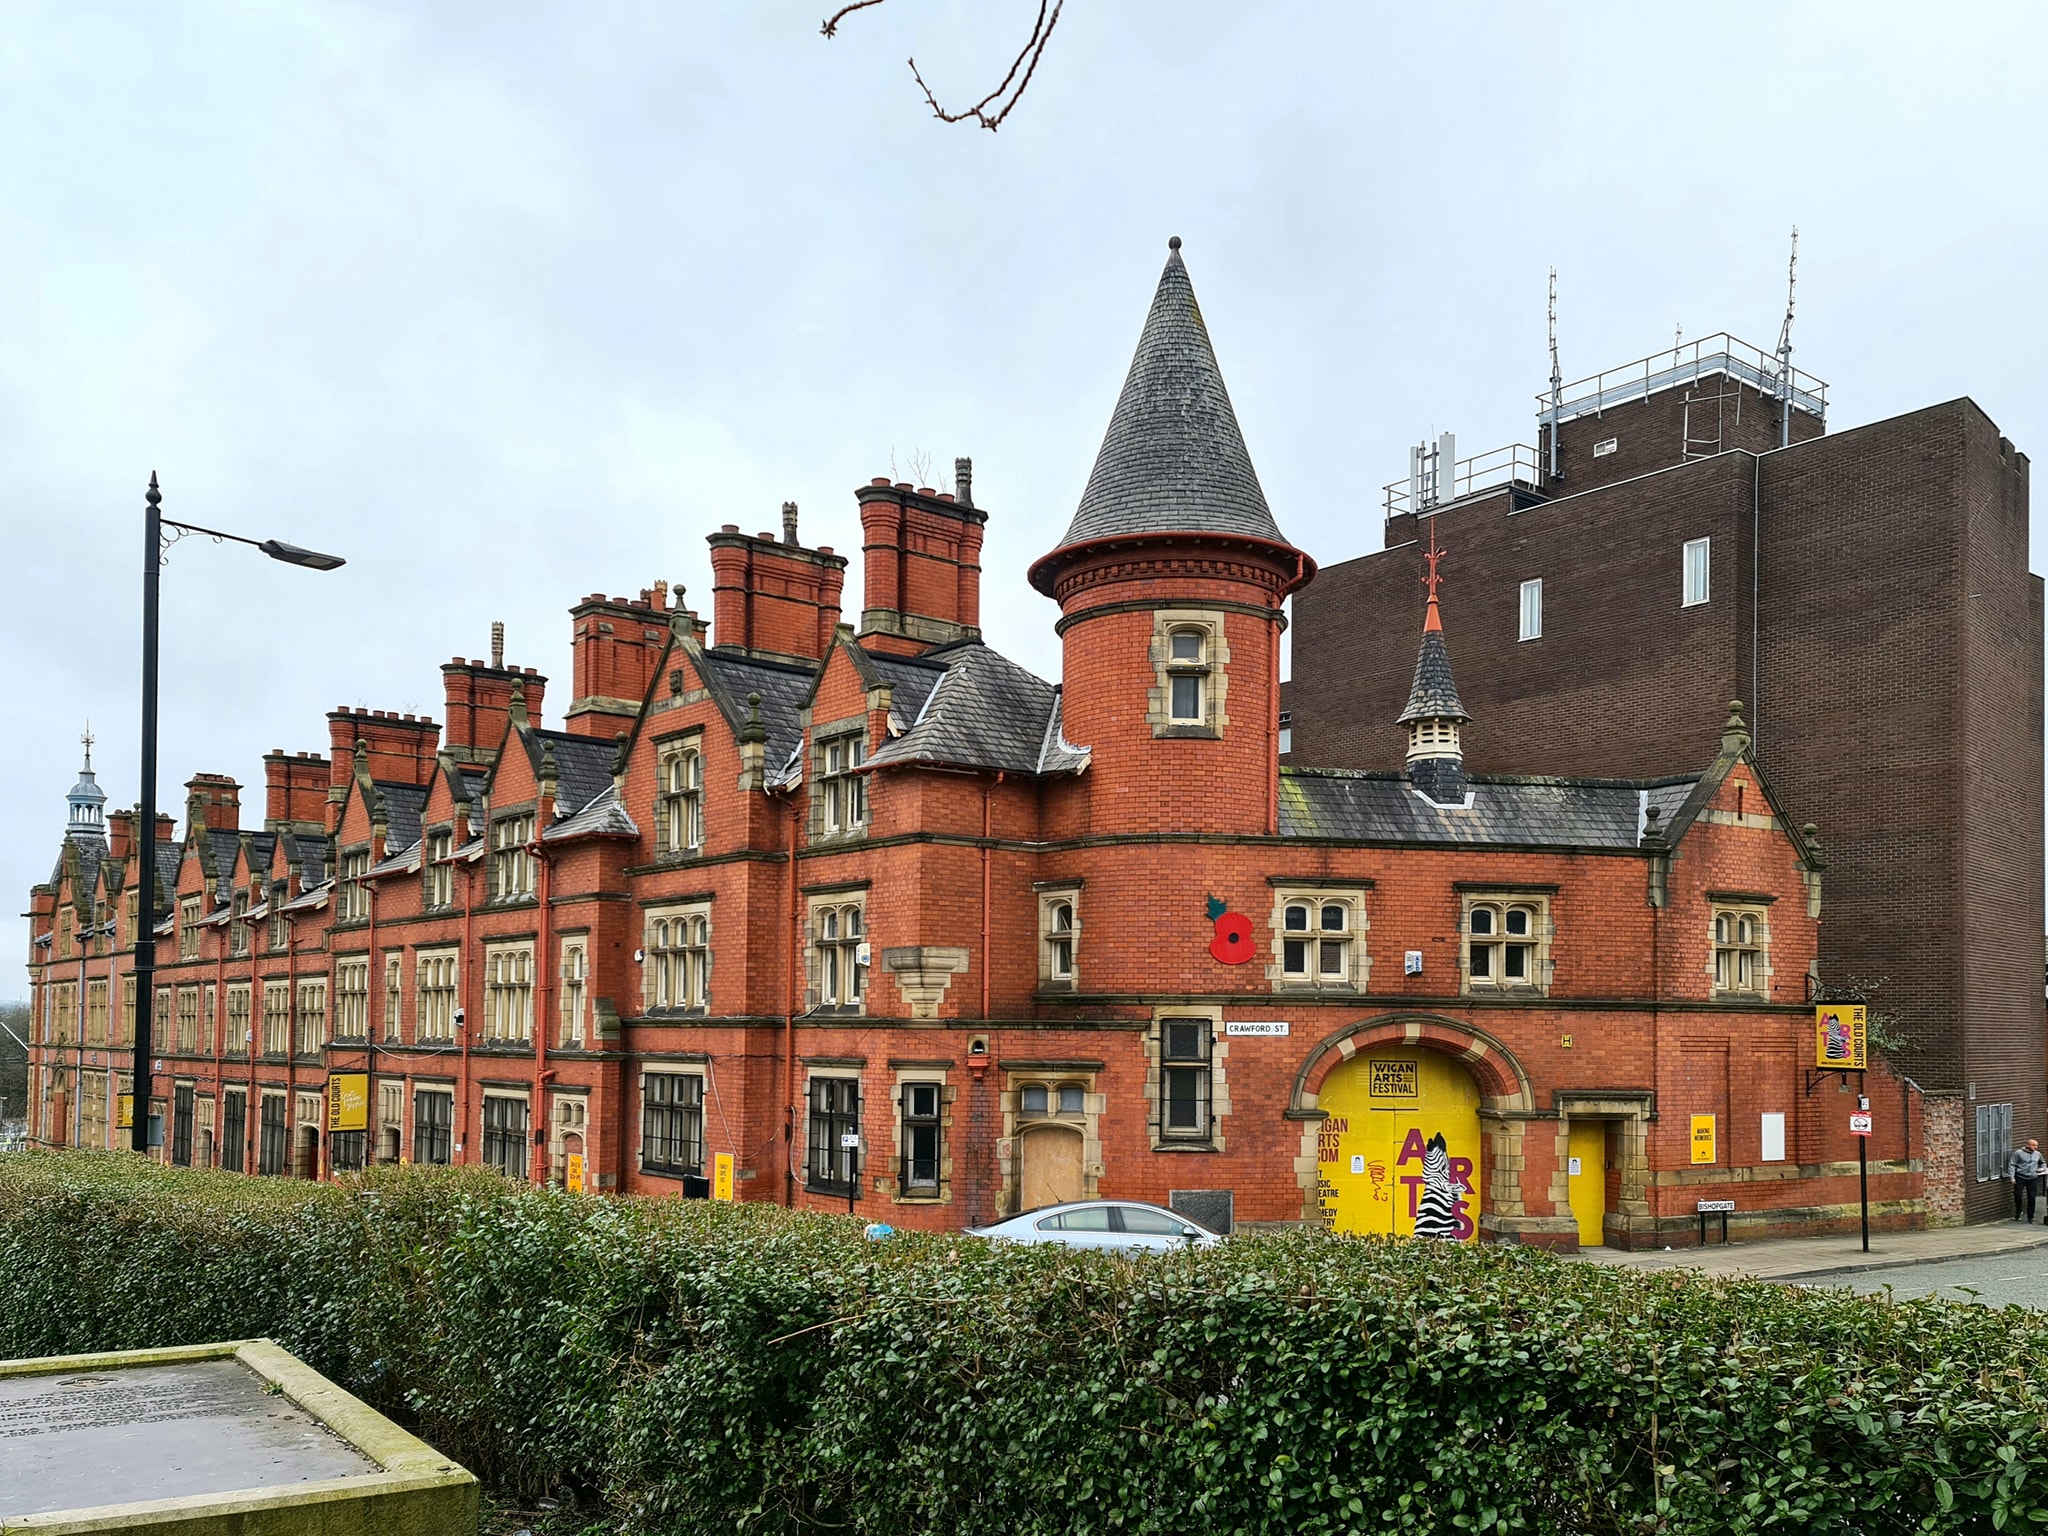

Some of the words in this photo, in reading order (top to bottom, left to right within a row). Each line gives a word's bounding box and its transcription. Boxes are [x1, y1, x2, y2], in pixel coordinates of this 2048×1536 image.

[1854, 1008, 1863, 1021] THE
[1854, 1023, 1863, 1037] OLD
[1854, 1038, 1863, 1067] COURTS
[1374, 1064, 1414, 1073] WIGAN
[1374, 1073, 1403, 1082] ARTS
[331, 1077, 341, 1101] COURTS
[1373, 1083, 1414, 1093] FESTIVAL
[331, 1102, 341, 1116] OLD
[331, 1117, 340, 1129] THE
[1320, 1119, 1348, 1132] IGAN
[1318, 1134, 1340, 1147] RTS
[1318, 1149, 1339, 1162] OM
[1318, 1180, 1331, 1188] SIC
[1318, 1189, 1339, 1198] EATRE
[1698, 1202, 1734, 1210] BISHOPGATE
